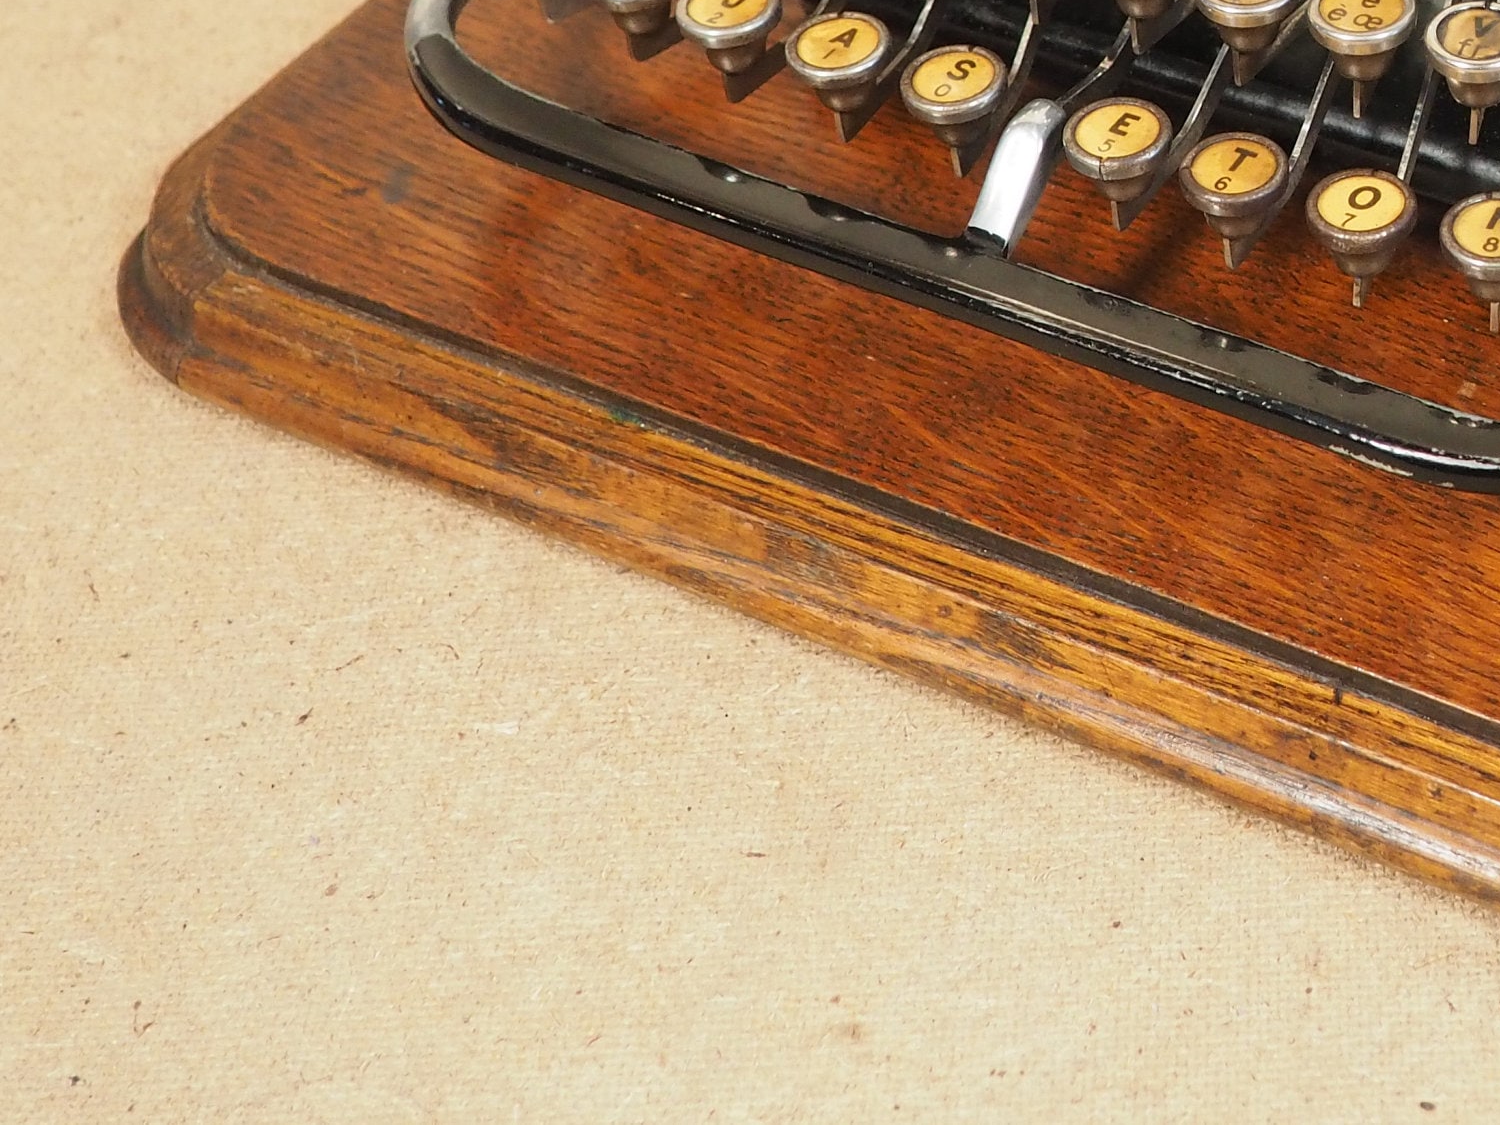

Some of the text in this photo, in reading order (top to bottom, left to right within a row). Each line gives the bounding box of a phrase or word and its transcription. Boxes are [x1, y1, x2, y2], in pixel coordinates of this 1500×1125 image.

[706, 13, 723, 24] 2
[1474, 16, 1500, 38] V
[829, 28, 858, 48] A
[947, 60, 976, 80] S
[1109, 112, 1141, 137] E
[1098, 138, 1116, 153] 5
[1229, 147, 1258, 172] T
[1214, 176, 1232, 191] 6
[1348, 185, 1382, 210] O
[1341, 213, 1358, 227] 7
[1482, 236, 1500, 253] 8
